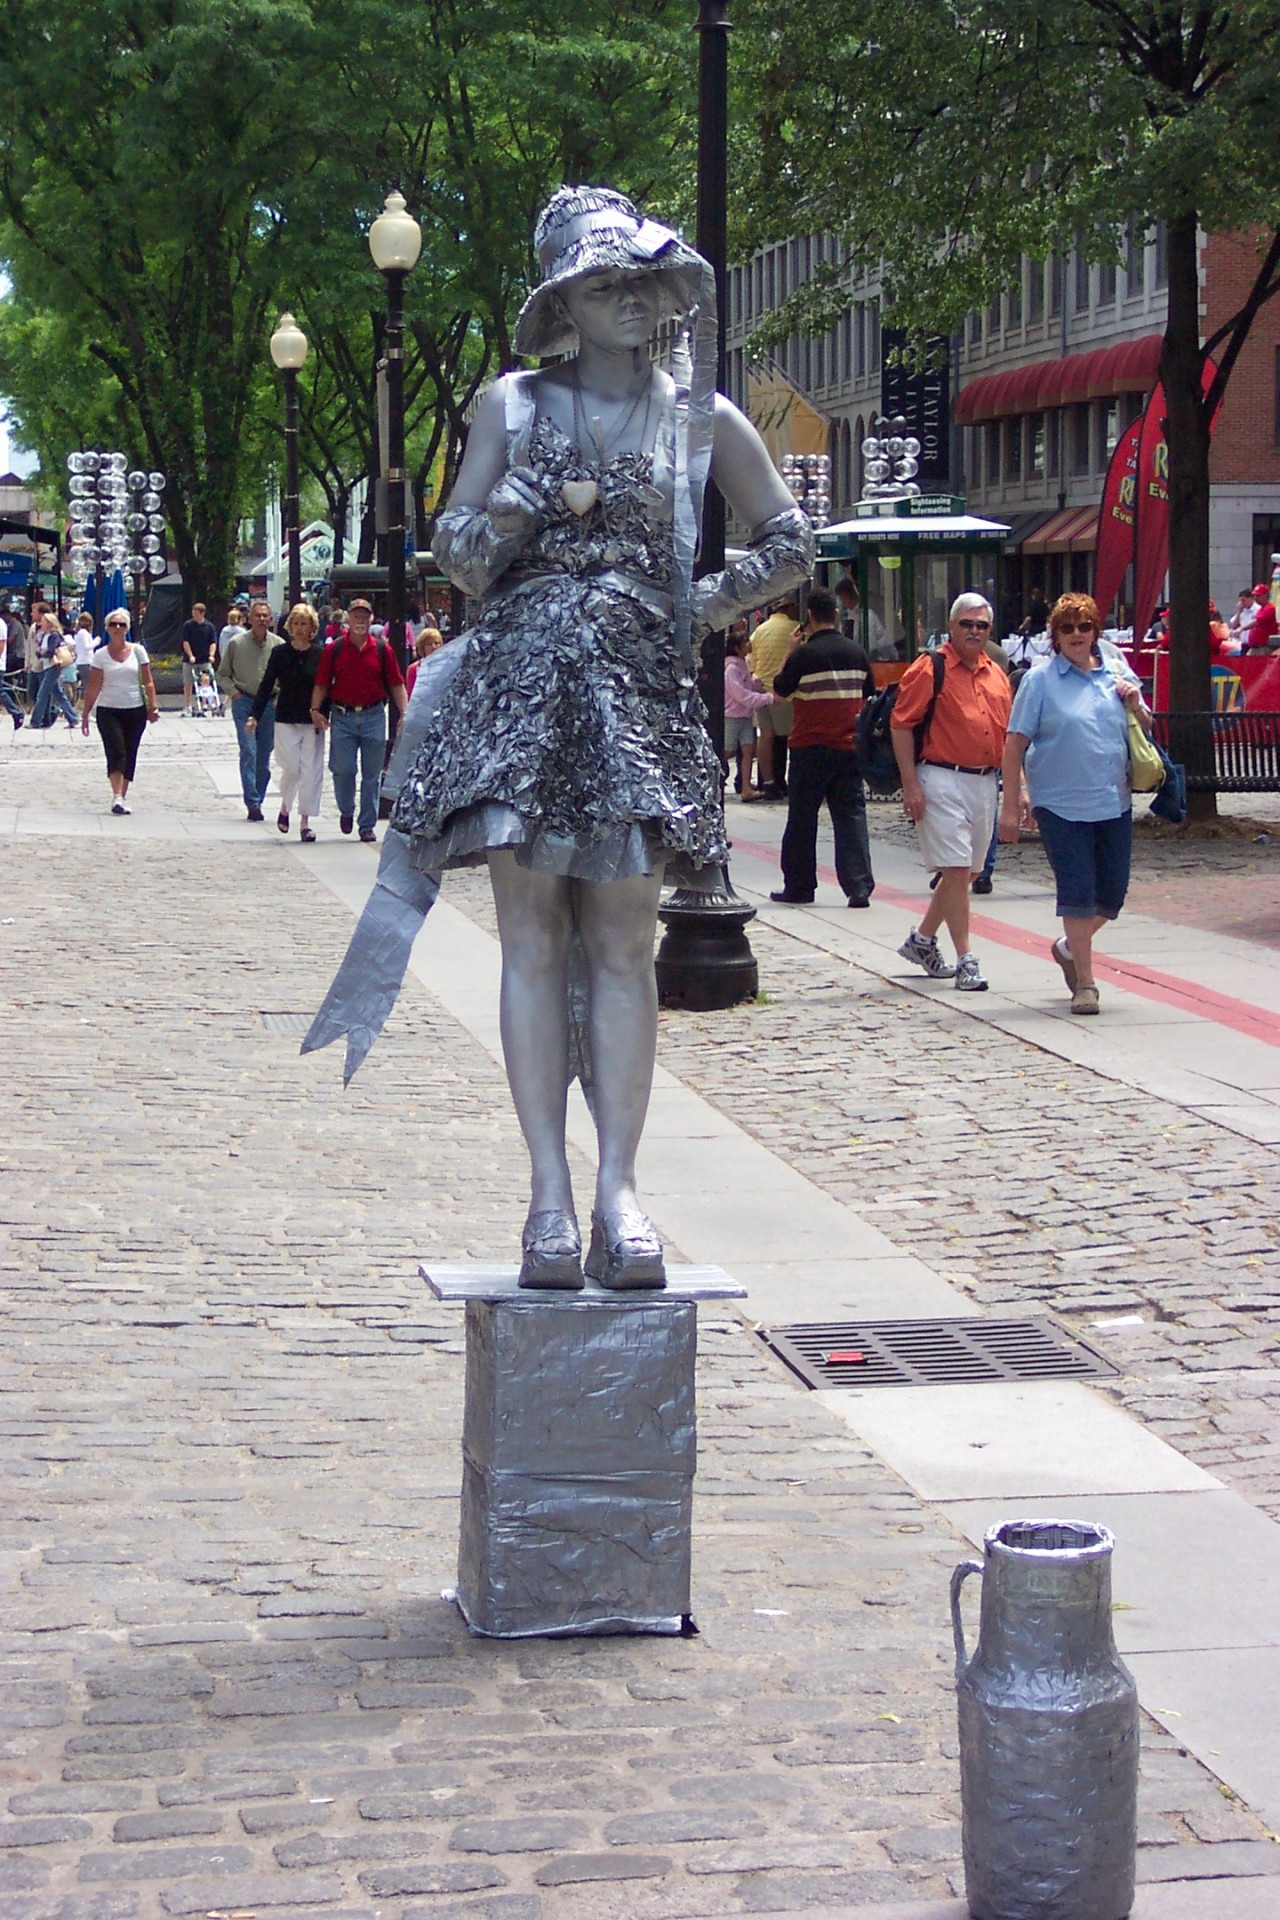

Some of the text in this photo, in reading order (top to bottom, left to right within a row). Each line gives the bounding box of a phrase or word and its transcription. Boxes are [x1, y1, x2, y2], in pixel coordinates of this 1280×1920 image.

[924, 382, 942, 461] TAYLOR
[911, 506, 952, 515] Information
[918, 531, 966, 541] FREE MAPS
